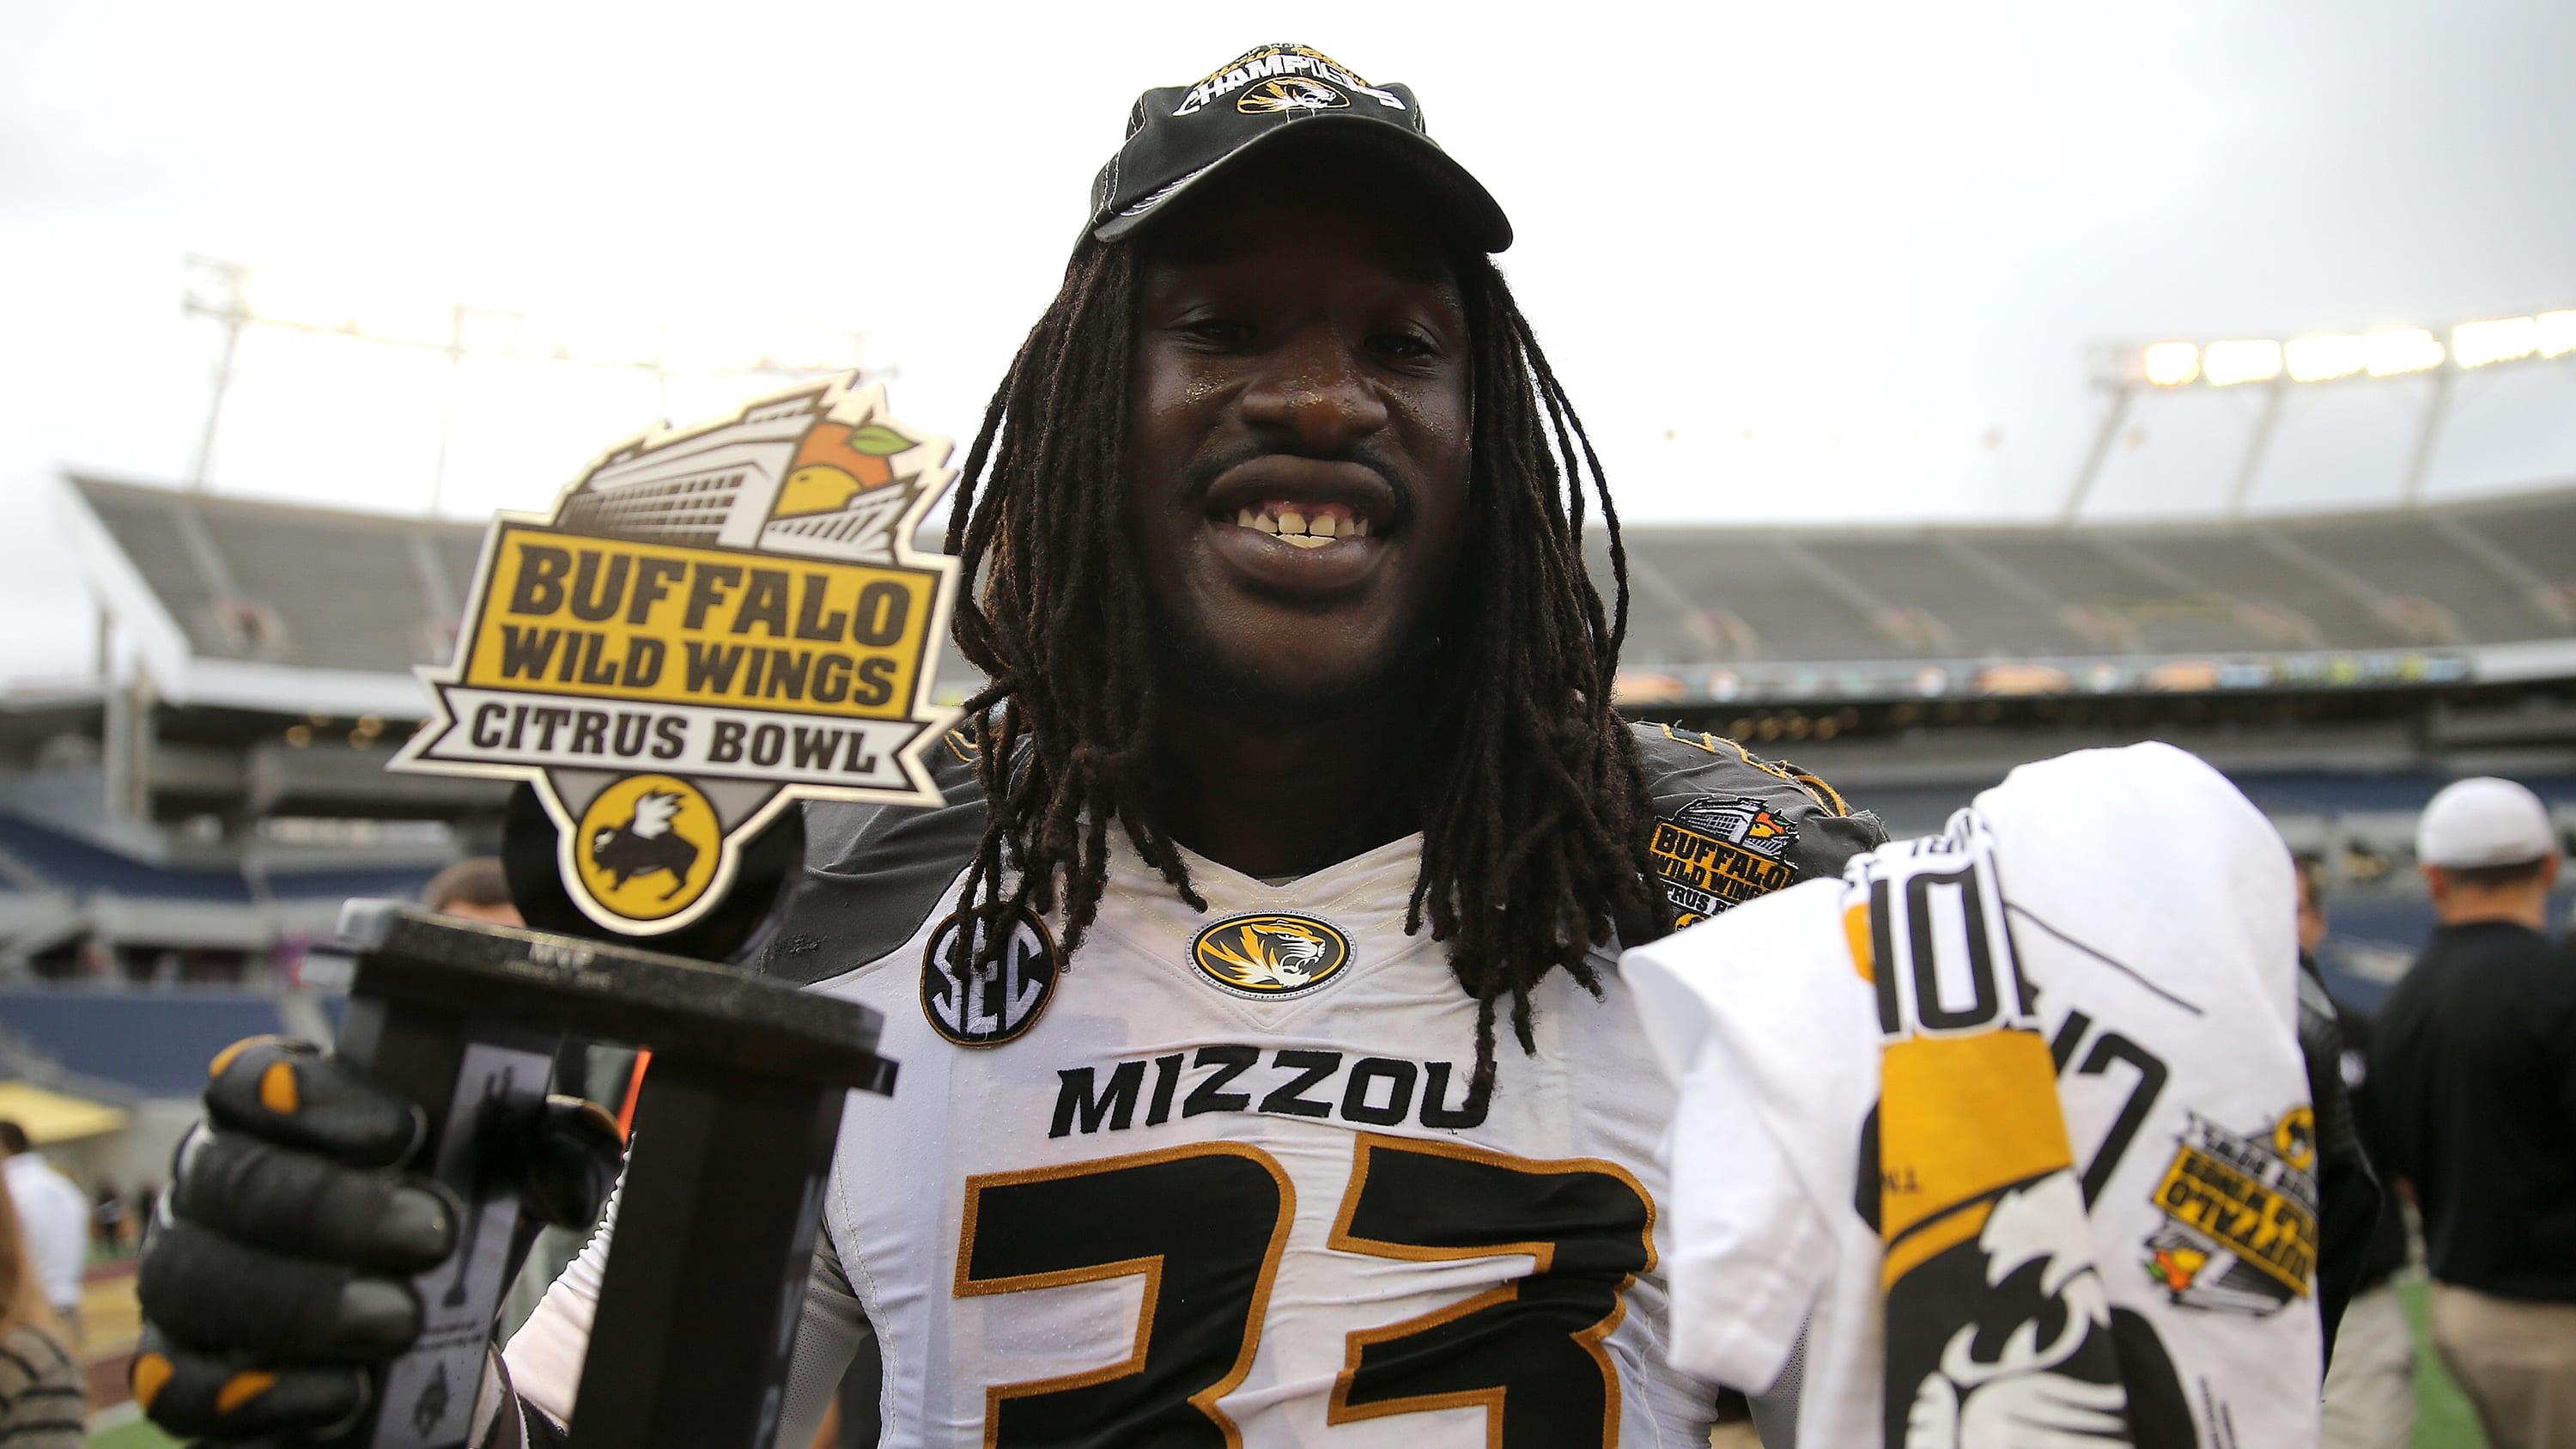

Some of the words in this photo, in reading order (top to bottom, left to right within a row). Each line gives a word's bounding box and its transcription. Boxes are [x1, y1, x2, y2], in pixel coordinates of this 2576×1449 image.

[507, 541, 914, 648] BUFFALO
[499, 624, 667, 688] WILD
[684, 640, 898, 707] WINGS
[470, 702, 688, 761] CITRUS
[708, 720, 878, 775] BOWL
[1656, 827, 1785, 891] BUFFALO
[932, 916, 1044, 1034] SEC
[1048, 1046, 1498, 1140] MIZZOU
[953, 1131, 1657, 1449] 33
